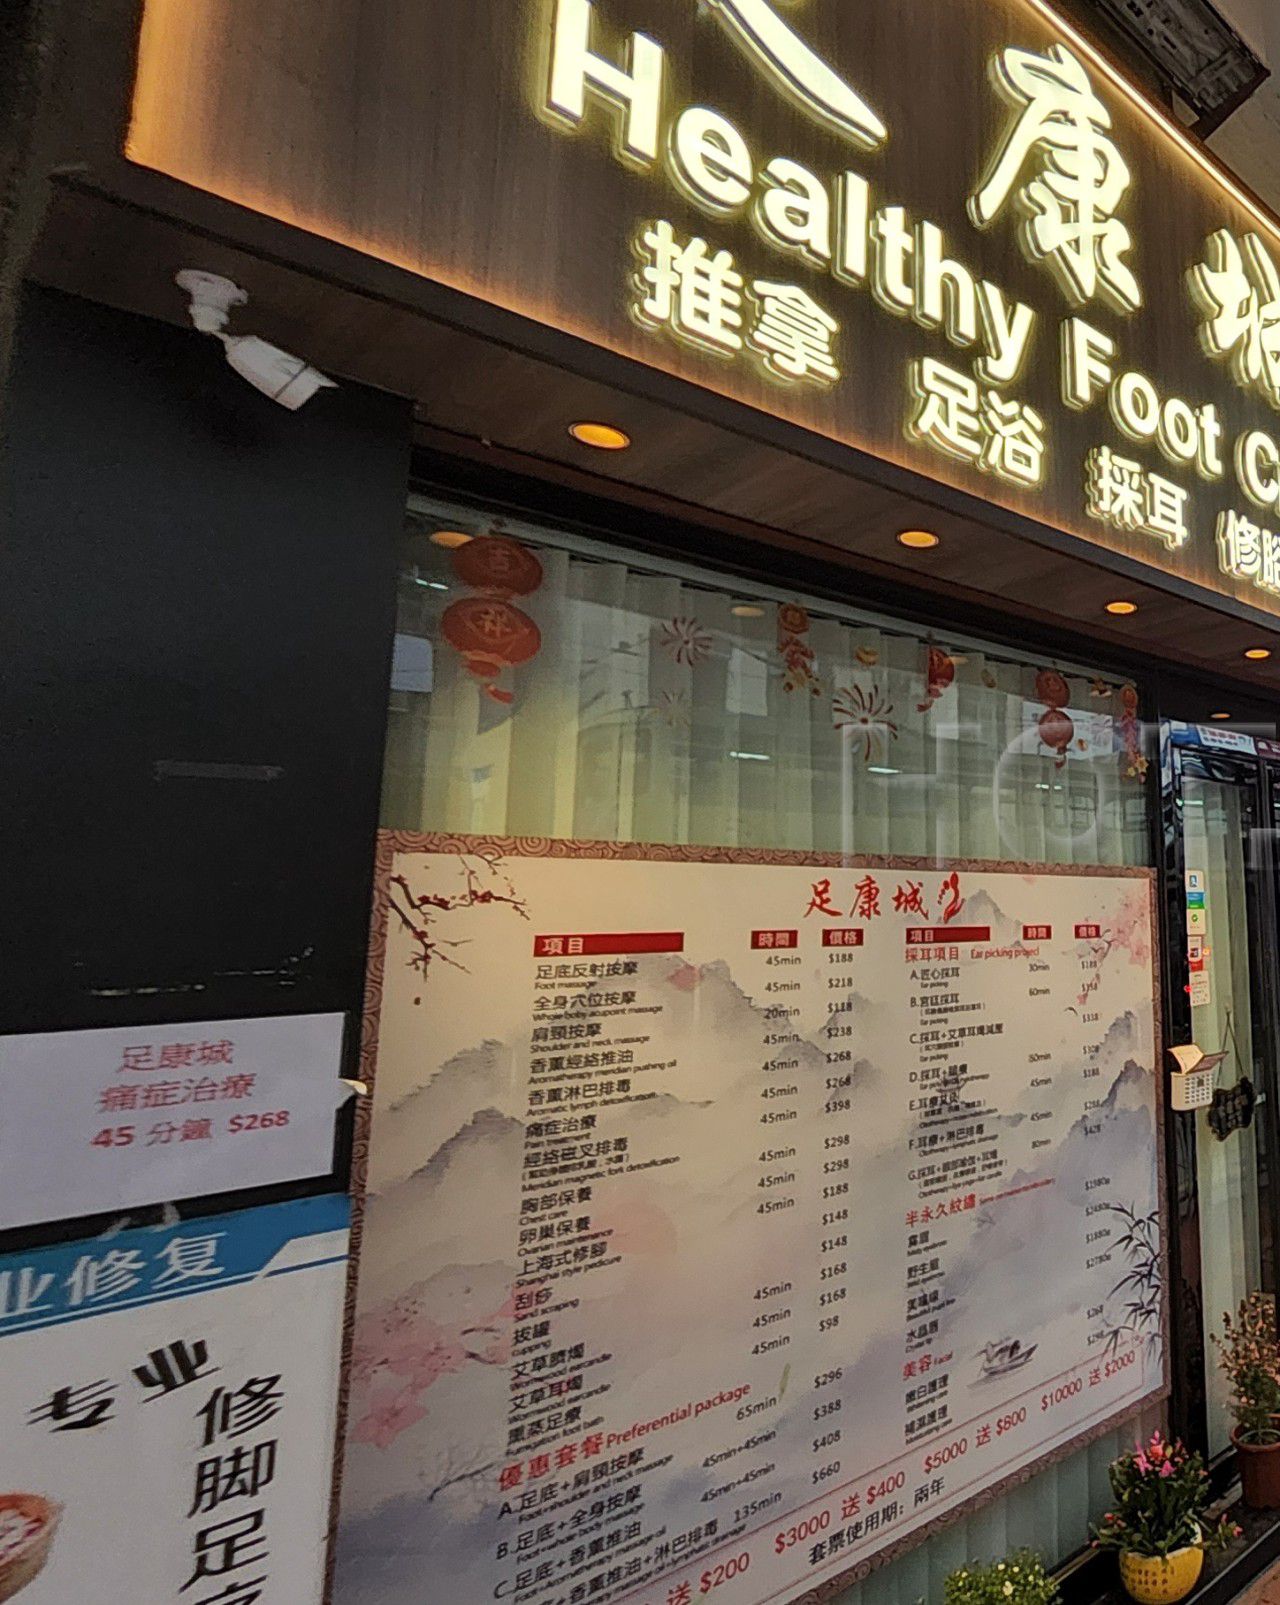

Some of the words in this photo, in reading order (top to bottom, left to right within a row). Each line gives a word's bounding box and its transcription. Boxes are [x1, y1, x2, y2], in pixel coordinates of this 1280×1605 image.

[540, 0, 1034, 385] Healthy
[1061, 316, 1223, 478] Foot
[634, 220, 840, 382] 推拿
[908, 356, 1044, 488] 足浴
[116, 1039, 235, 1073] 足康城
[96, 1072, 256, 1114] 痛症治療
[91, 1125, 136, 1149] 45
[227, 1109, 291, 1133] $268
[606, 1404, 692, 1448] Preferential
[694, 1384, 751, 1419] package
[700, 1553, 750, 1594] $200
[775, 1511, 831, 1554] $3000
[866, 1471, 905, 1505] $400
[923, 1438, 968, 1474] $5000
[996, 1407, 1027, 1438] $800
[1041, 1378, 1083, 1411] $10000
[1103, 1350, 1135, 1378] $2000
